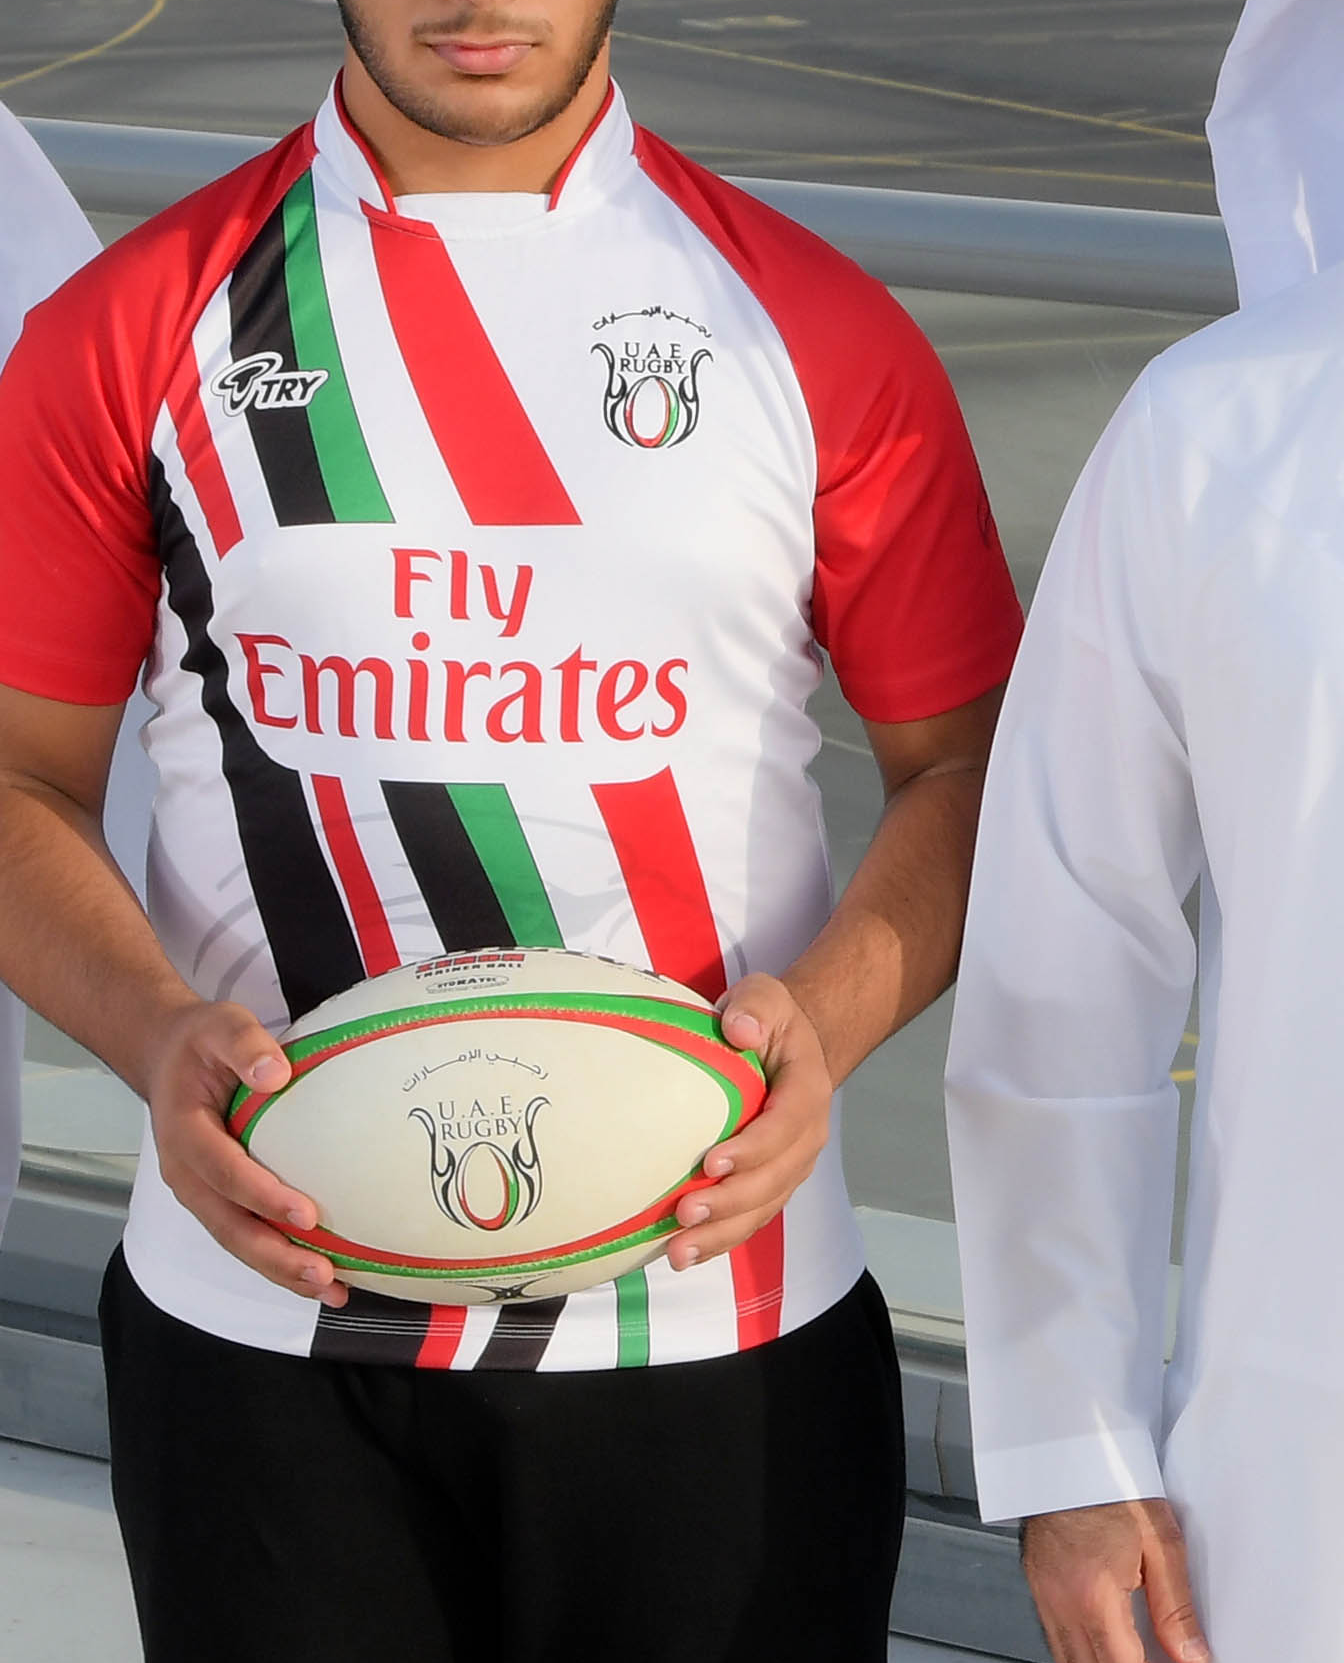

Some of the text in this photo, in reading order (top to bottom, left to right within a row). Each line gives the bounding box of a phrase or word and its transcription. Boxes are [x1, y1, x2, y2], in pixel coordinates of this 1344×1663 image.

[619, 358, 687, 375] RUGBY
[260, 375, 323, 404] TRY
[390, 548, 533, 637] Fly
[232, 631, 689, 743] Emirates
[440, 1116, 522, 1140] RUGBY
